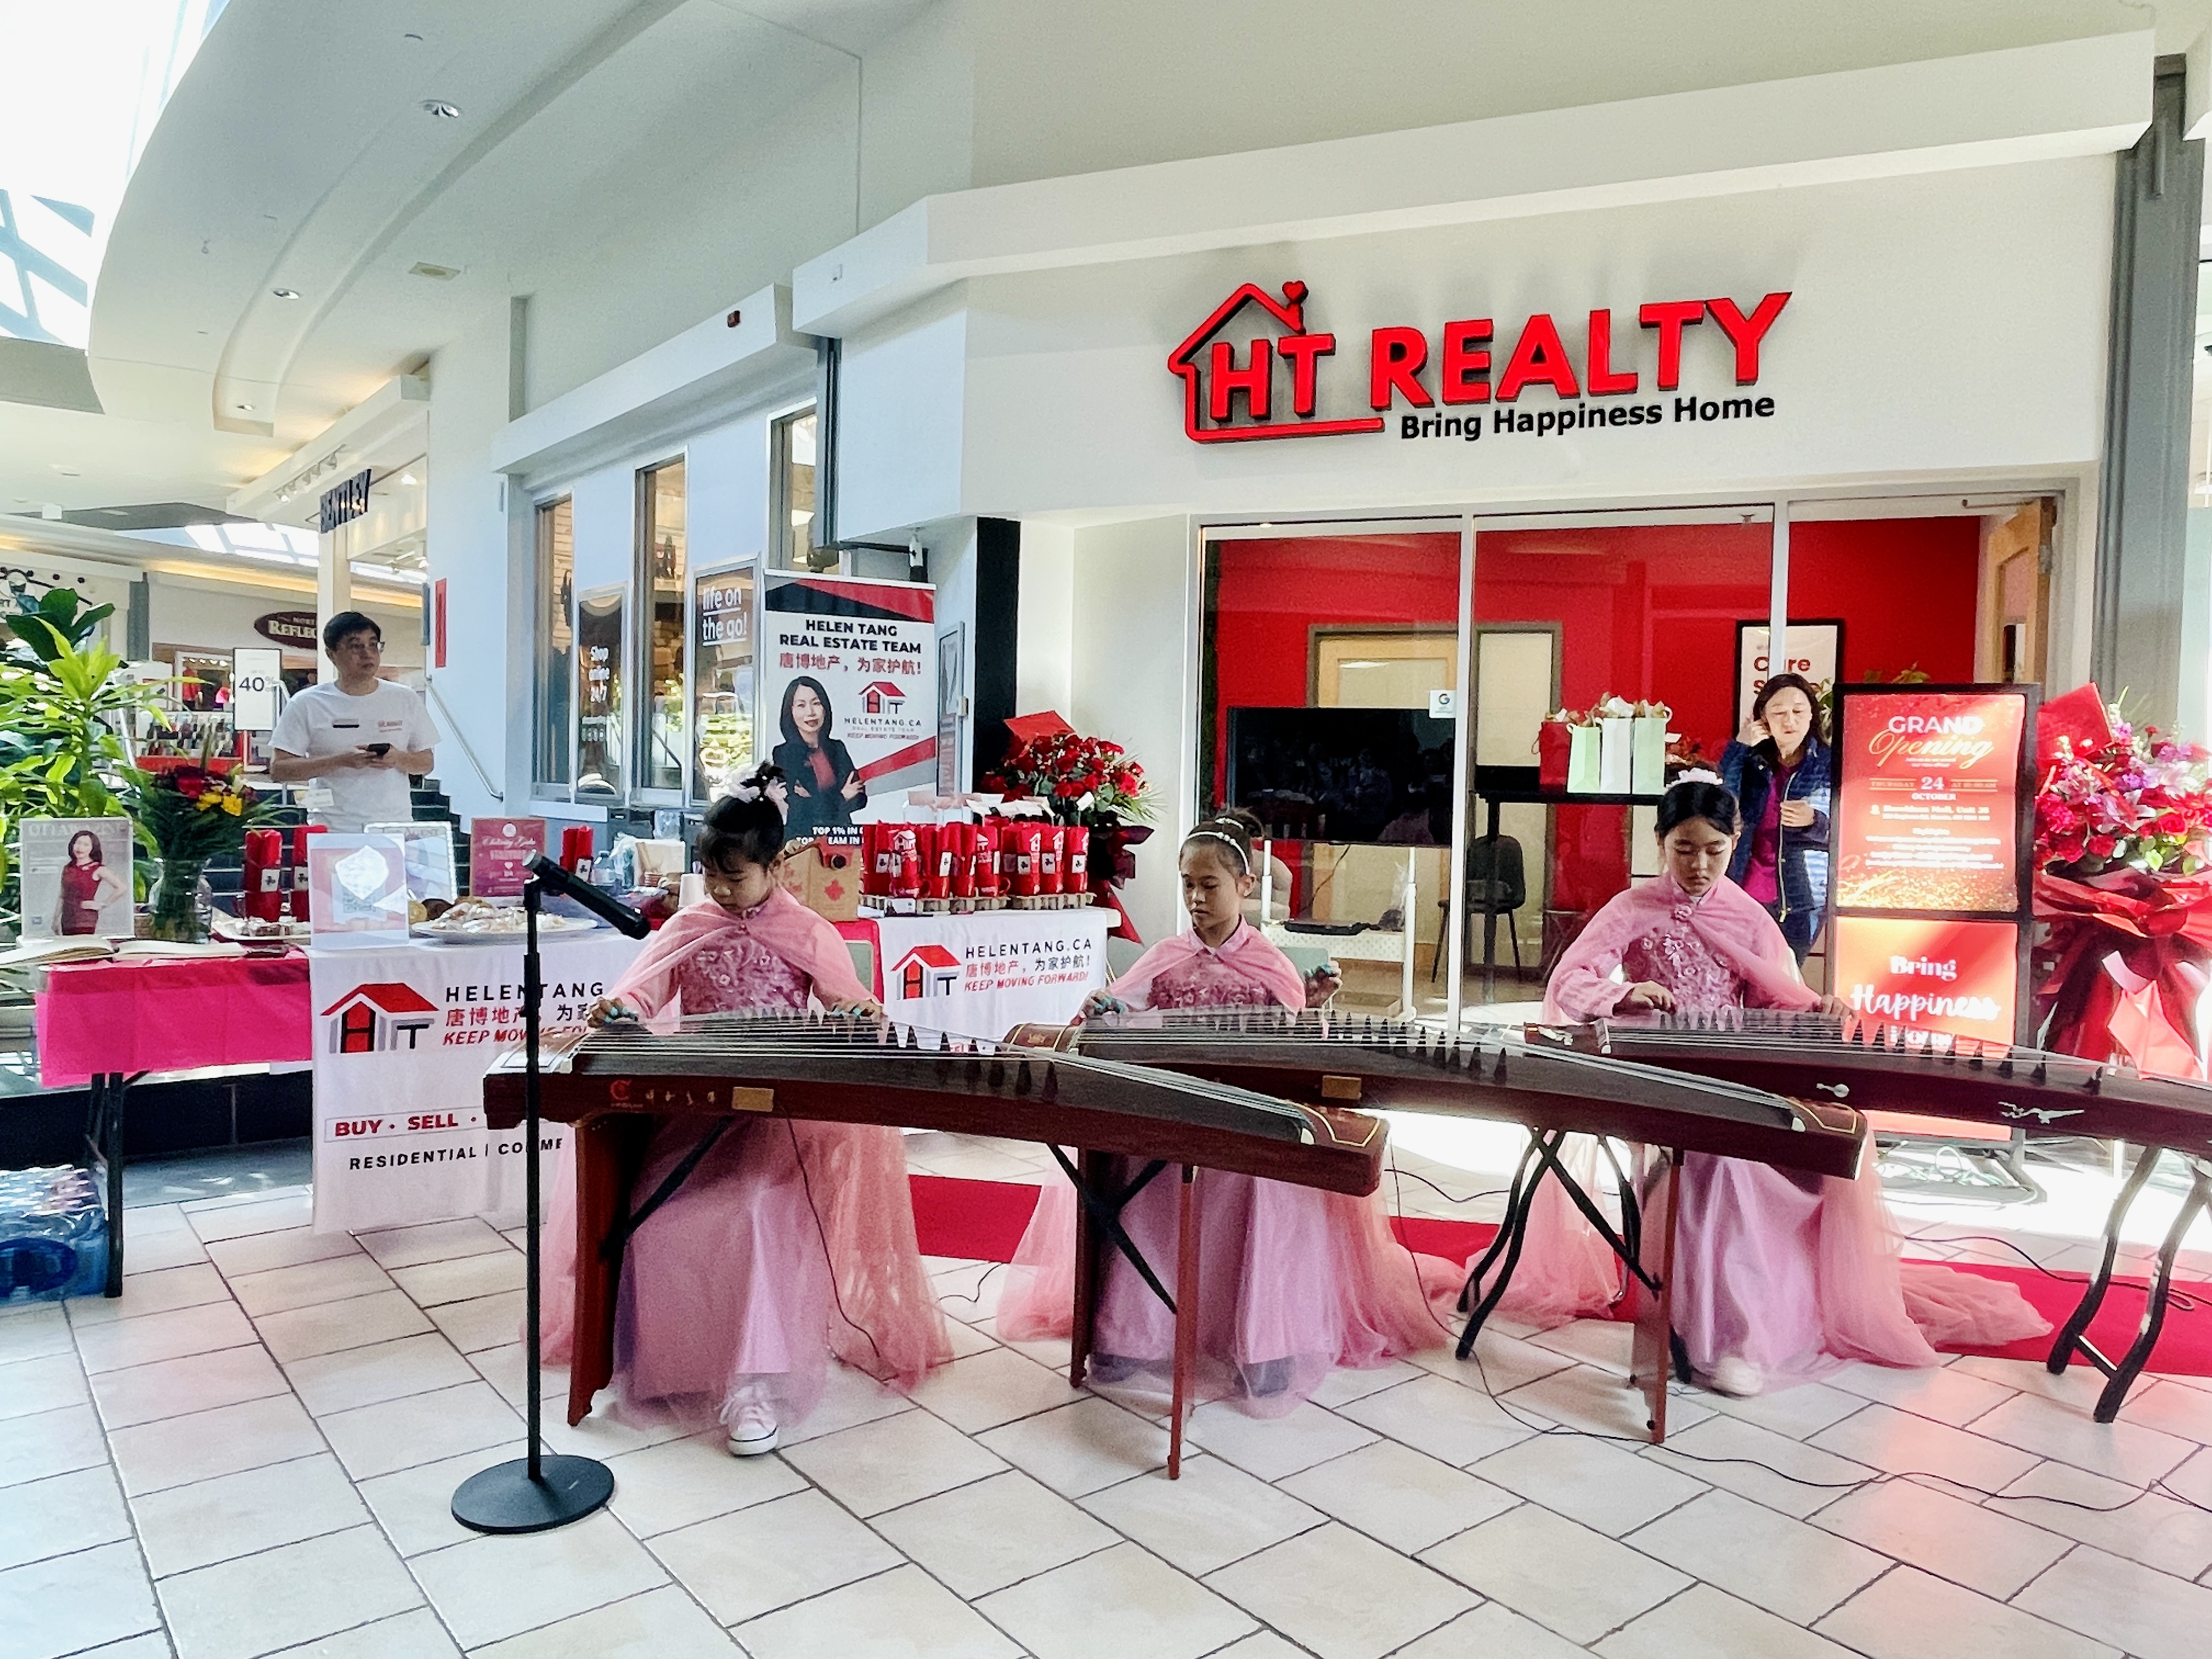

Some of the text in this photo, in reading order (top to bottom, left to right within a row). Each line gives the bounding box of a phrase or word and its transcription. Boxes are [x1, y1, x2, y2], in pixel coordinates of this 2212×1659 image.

[1209, 291, 1793, 421] HT REALTY
[1401, 396, 1775, 441] Bring Happiness Home
[703, 585, 742, 610] life on
[703, 612, 747, 640] the go!
[806, 619, 898, 636] HELEN TANG
[780, 634, 922, 653] REAL ESTATE TEAM
[1754, 656, 1810, 672] Cre
[1888, 715, 1985, 735] GRAND
[1869, 728, 1995, 769] Opening
[1921, 777, 1944, 790] 24
[812, 827, 831, 835] TOP
[847, 827, 858, 835] IN
[849, 837, 860, 845] IN
[965, 938, 1092, 958] HELENTANG.CA
[1890, 955, 1957, 981] Bring
[964, 980, 993, 992] KEEP
[996, 975, 1035, 989] MOVING
[443, 1030, 490, 1046] KEEP
[334, 1113, 459, 1137] BUY SELL
[349, 1147, 477, 1170] RESIDENTIAL
